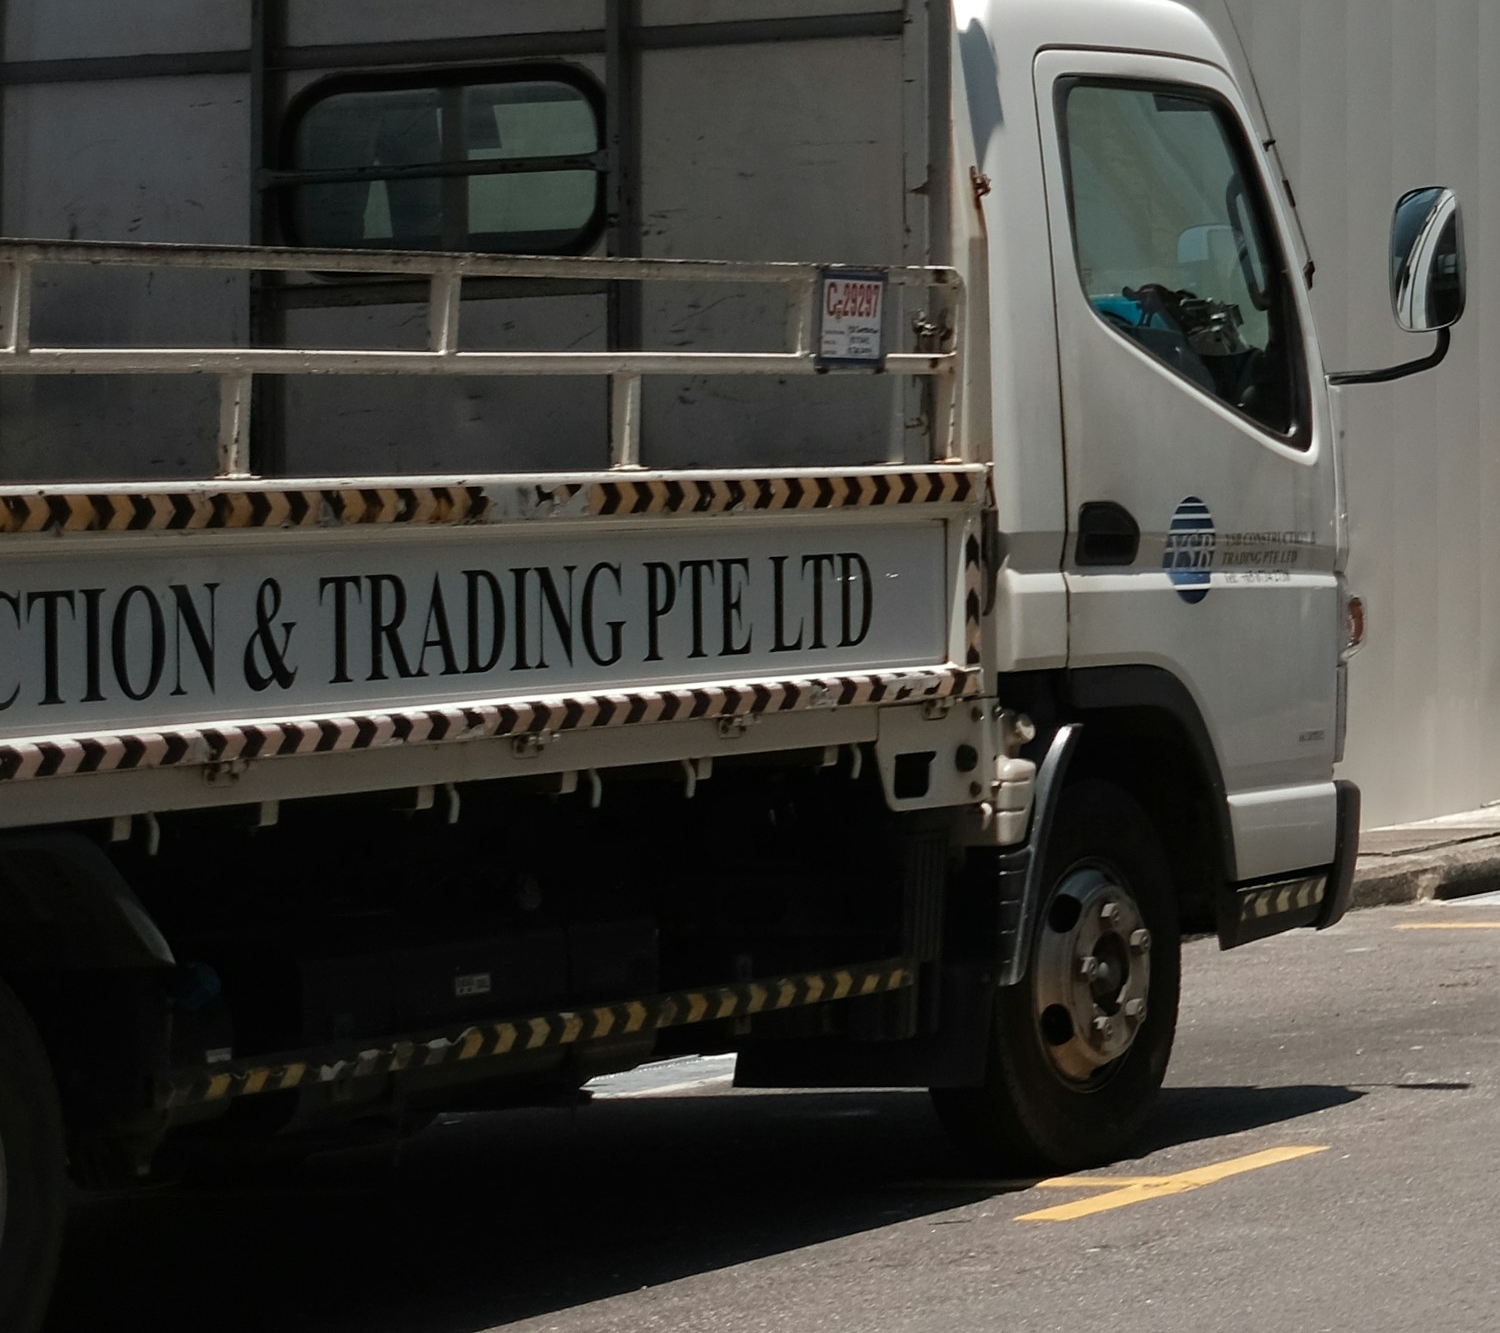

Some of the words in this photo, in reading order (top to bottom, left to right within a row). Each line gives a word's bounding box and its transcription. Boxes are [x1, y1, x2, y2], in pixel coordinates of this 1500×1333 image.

[1222, 551, 1261, 565] TRADING
[1261, 550, 1278, 564] PTE
[242, 577, 298, 693] &
[318, 562, 626, 684] TRADING
[642, 558, 753, 661] PTE
[768, 551, 874, 652] LTD
